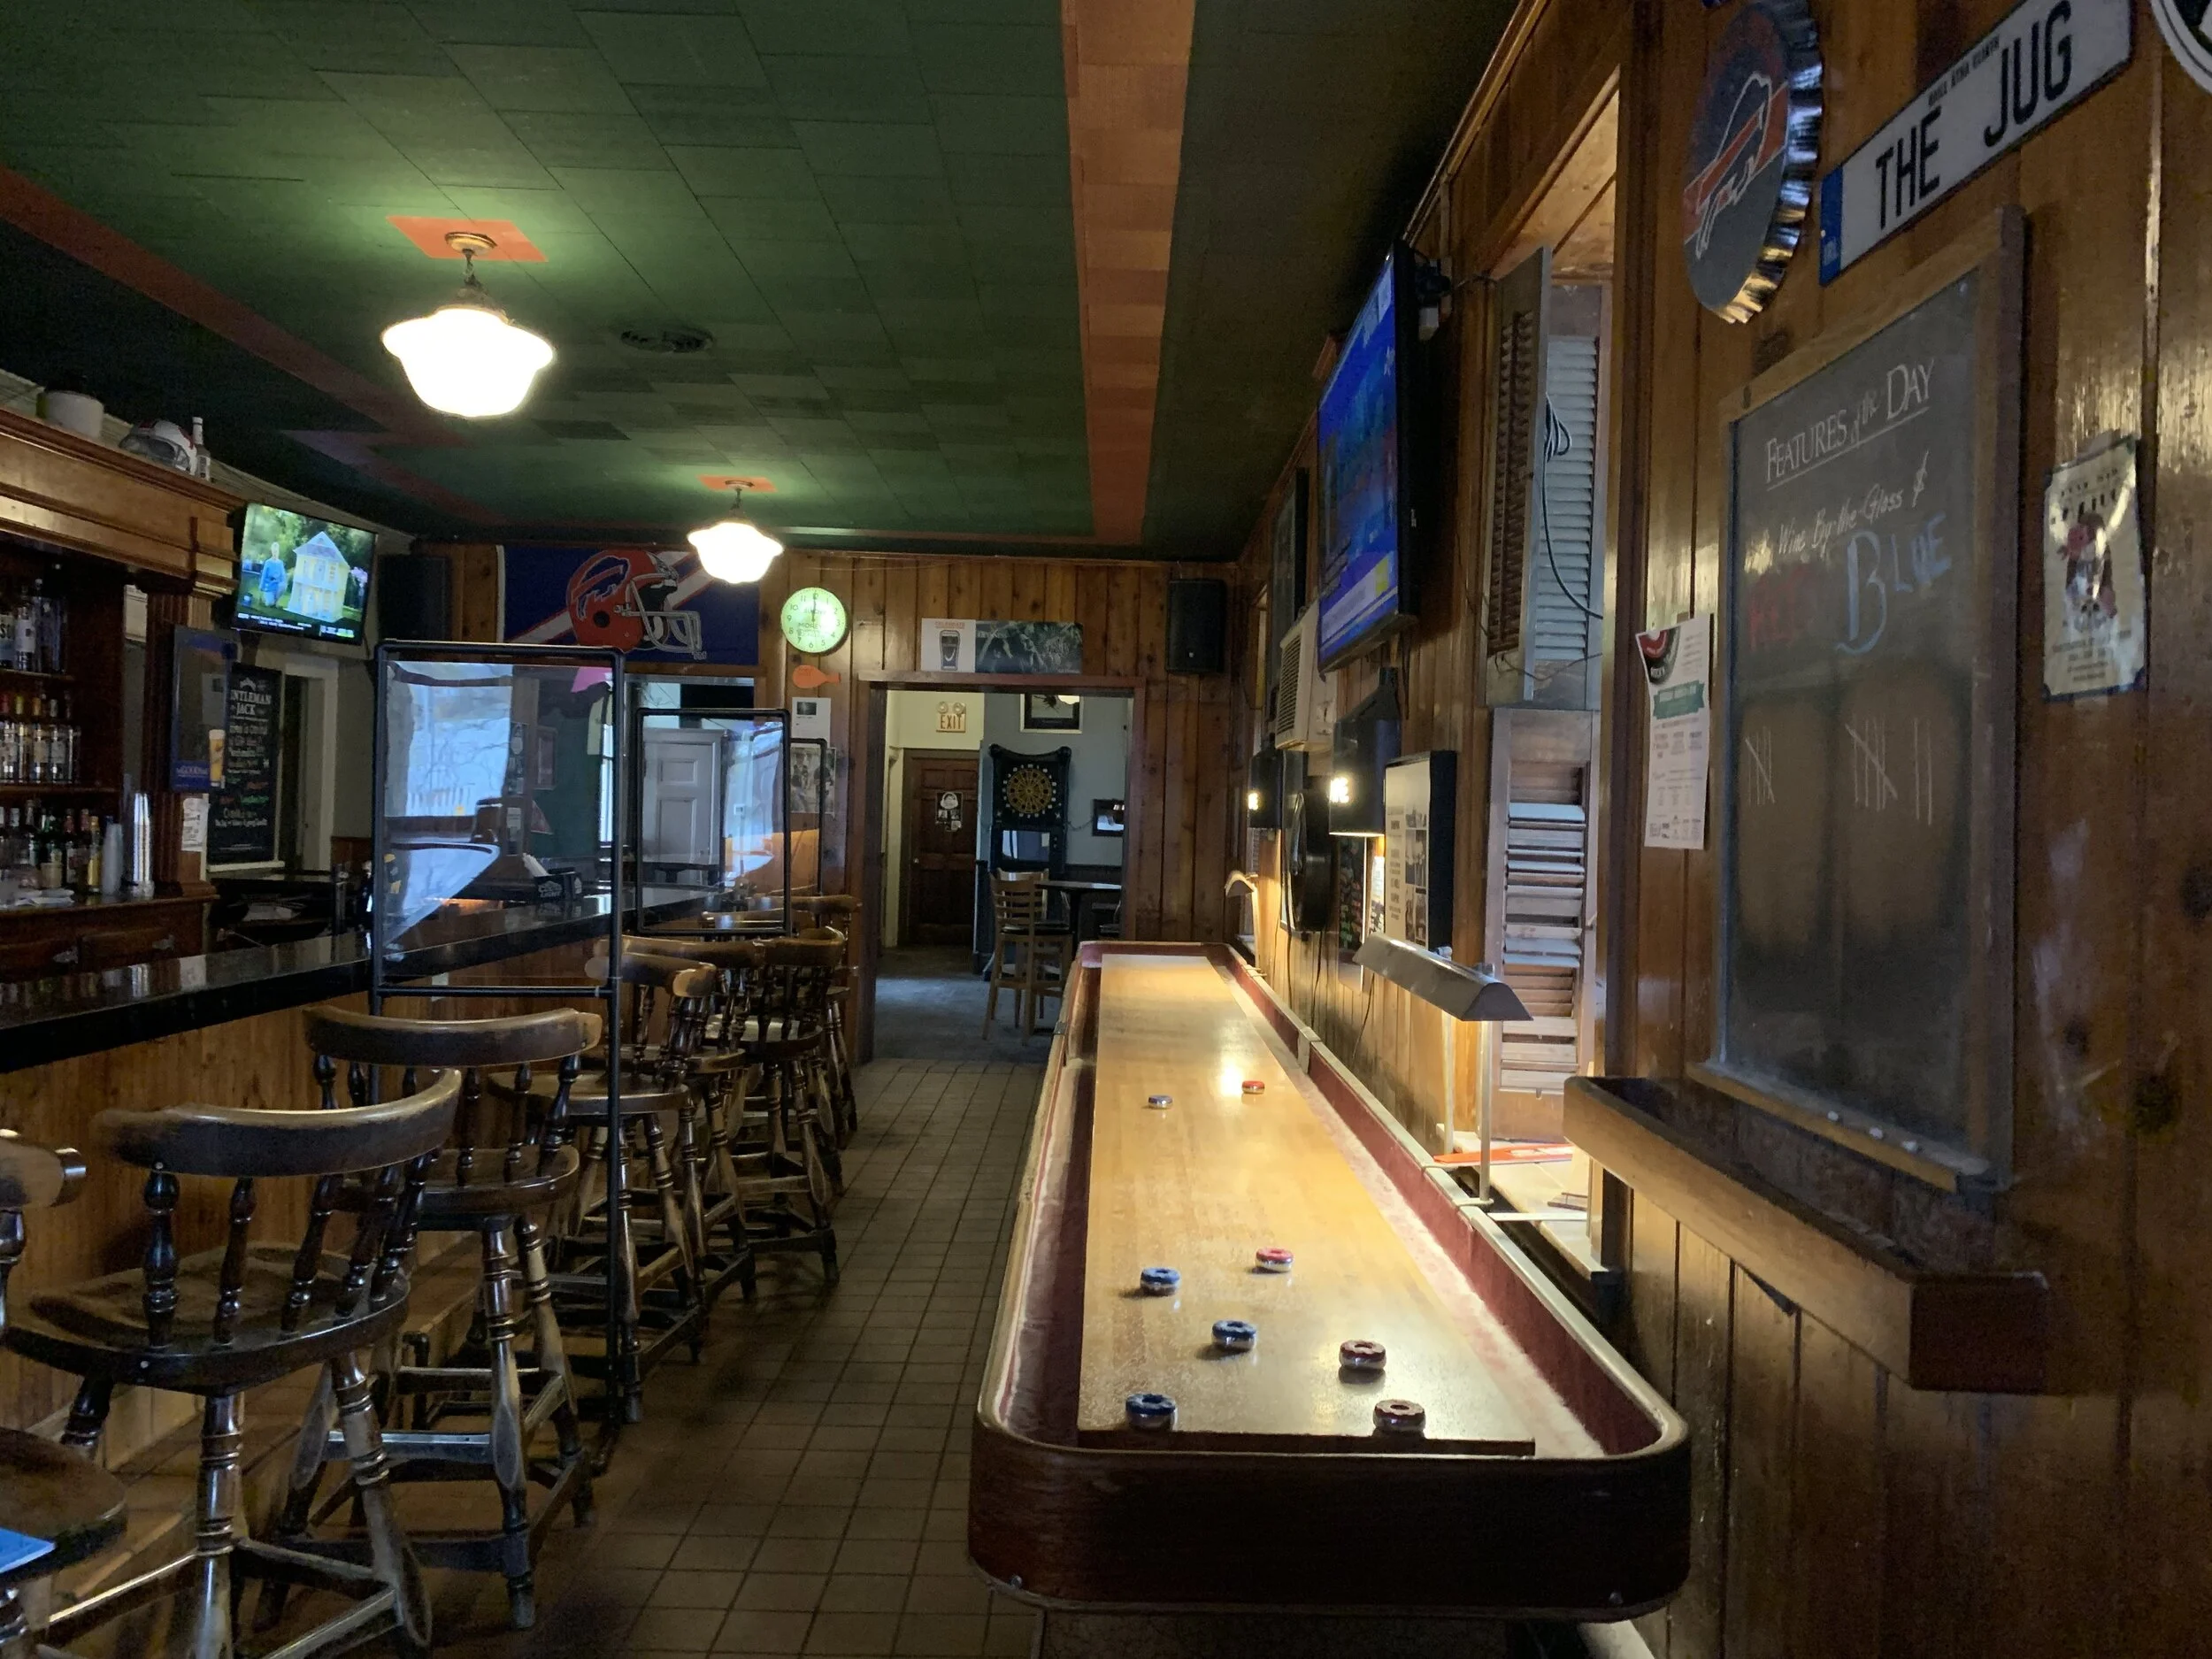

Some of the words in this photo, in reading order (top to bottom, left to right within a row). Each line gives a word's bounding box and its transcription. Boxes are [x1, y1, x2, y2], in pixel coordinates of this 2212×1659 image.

[1875, 104, 1942, 231] THE
[1983, 0, 2073, 148] JUG
[1765, 409, 1848, 484] FEATURES
[235, 702, 257, 716] JACK
[940, 714, 962, 730] EXIT
